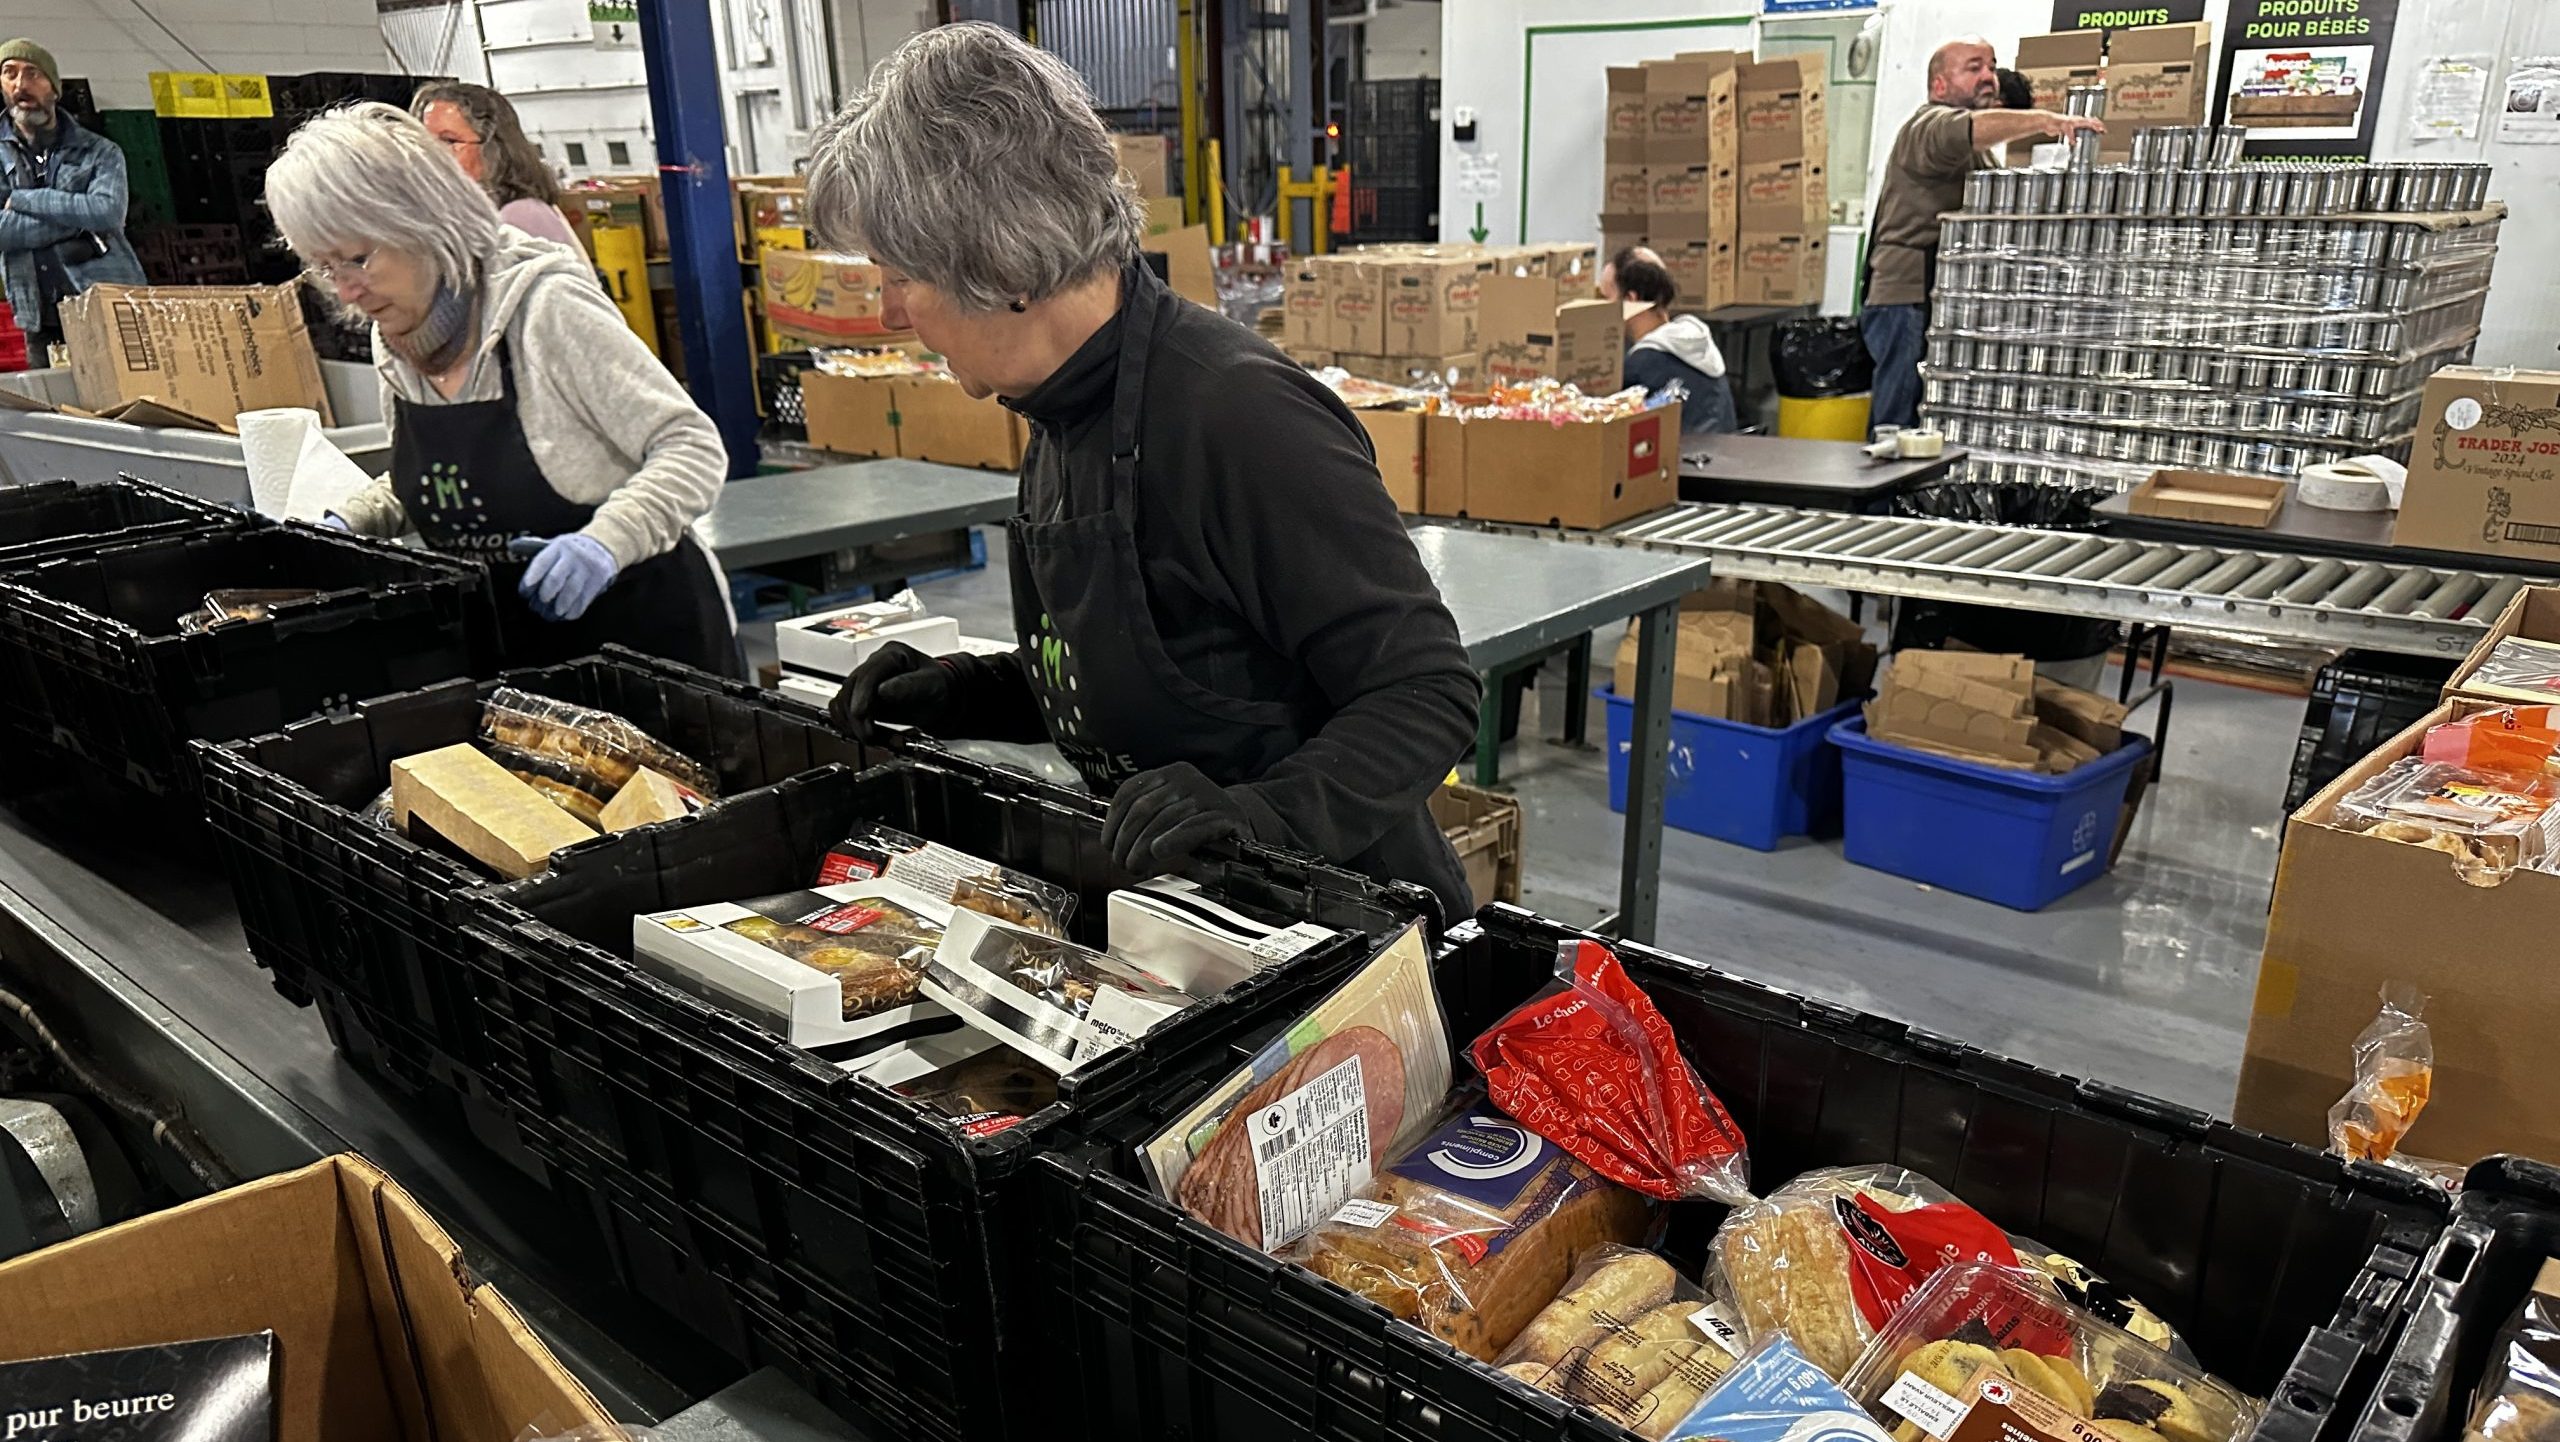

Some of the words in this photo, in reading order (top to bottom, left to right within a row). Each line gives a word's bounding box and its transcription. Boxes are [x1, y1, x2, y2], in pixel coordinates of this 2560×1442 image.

[2258, 0, 2359, 17] PRODUITS
[2079, 9, 2168, 27] PRODUITS
[2246, 22, 2298, 38] POUR
[2305, 18, 2370, 36] BÉBÉS
[2458, 437, 2522, 453] TRADER
[2491, 452, 2526, 467] 2024
[1090, 1018, 1117, 1035] metro
[1532, 1013, 1553, 1029] Le
[990, 1114, 1019, 1124] rabais
[1486, 1134, 1513, 1146] BRIOCHE
[1440, 1139, 1500, 1161] compliments
[1704, 1316, 1735, 1337] IGA
[1600, 1360, 1636, 1388] Artisan
[1796, 1367, 1819, 1389] 480
[1786, 1375, 1801, 1392] g
[1902, 1379, 1924, 1394] AVANT
[6, 1409, 64, 1436] pur
[74, 1388, 175, 1425] beurre
[1908, 1401, 1938, 1422] EMBALLÉ
[1924, 1393, 1955, 1414] MEILLEUR
[2072, 1423, 2085, 1434] g
